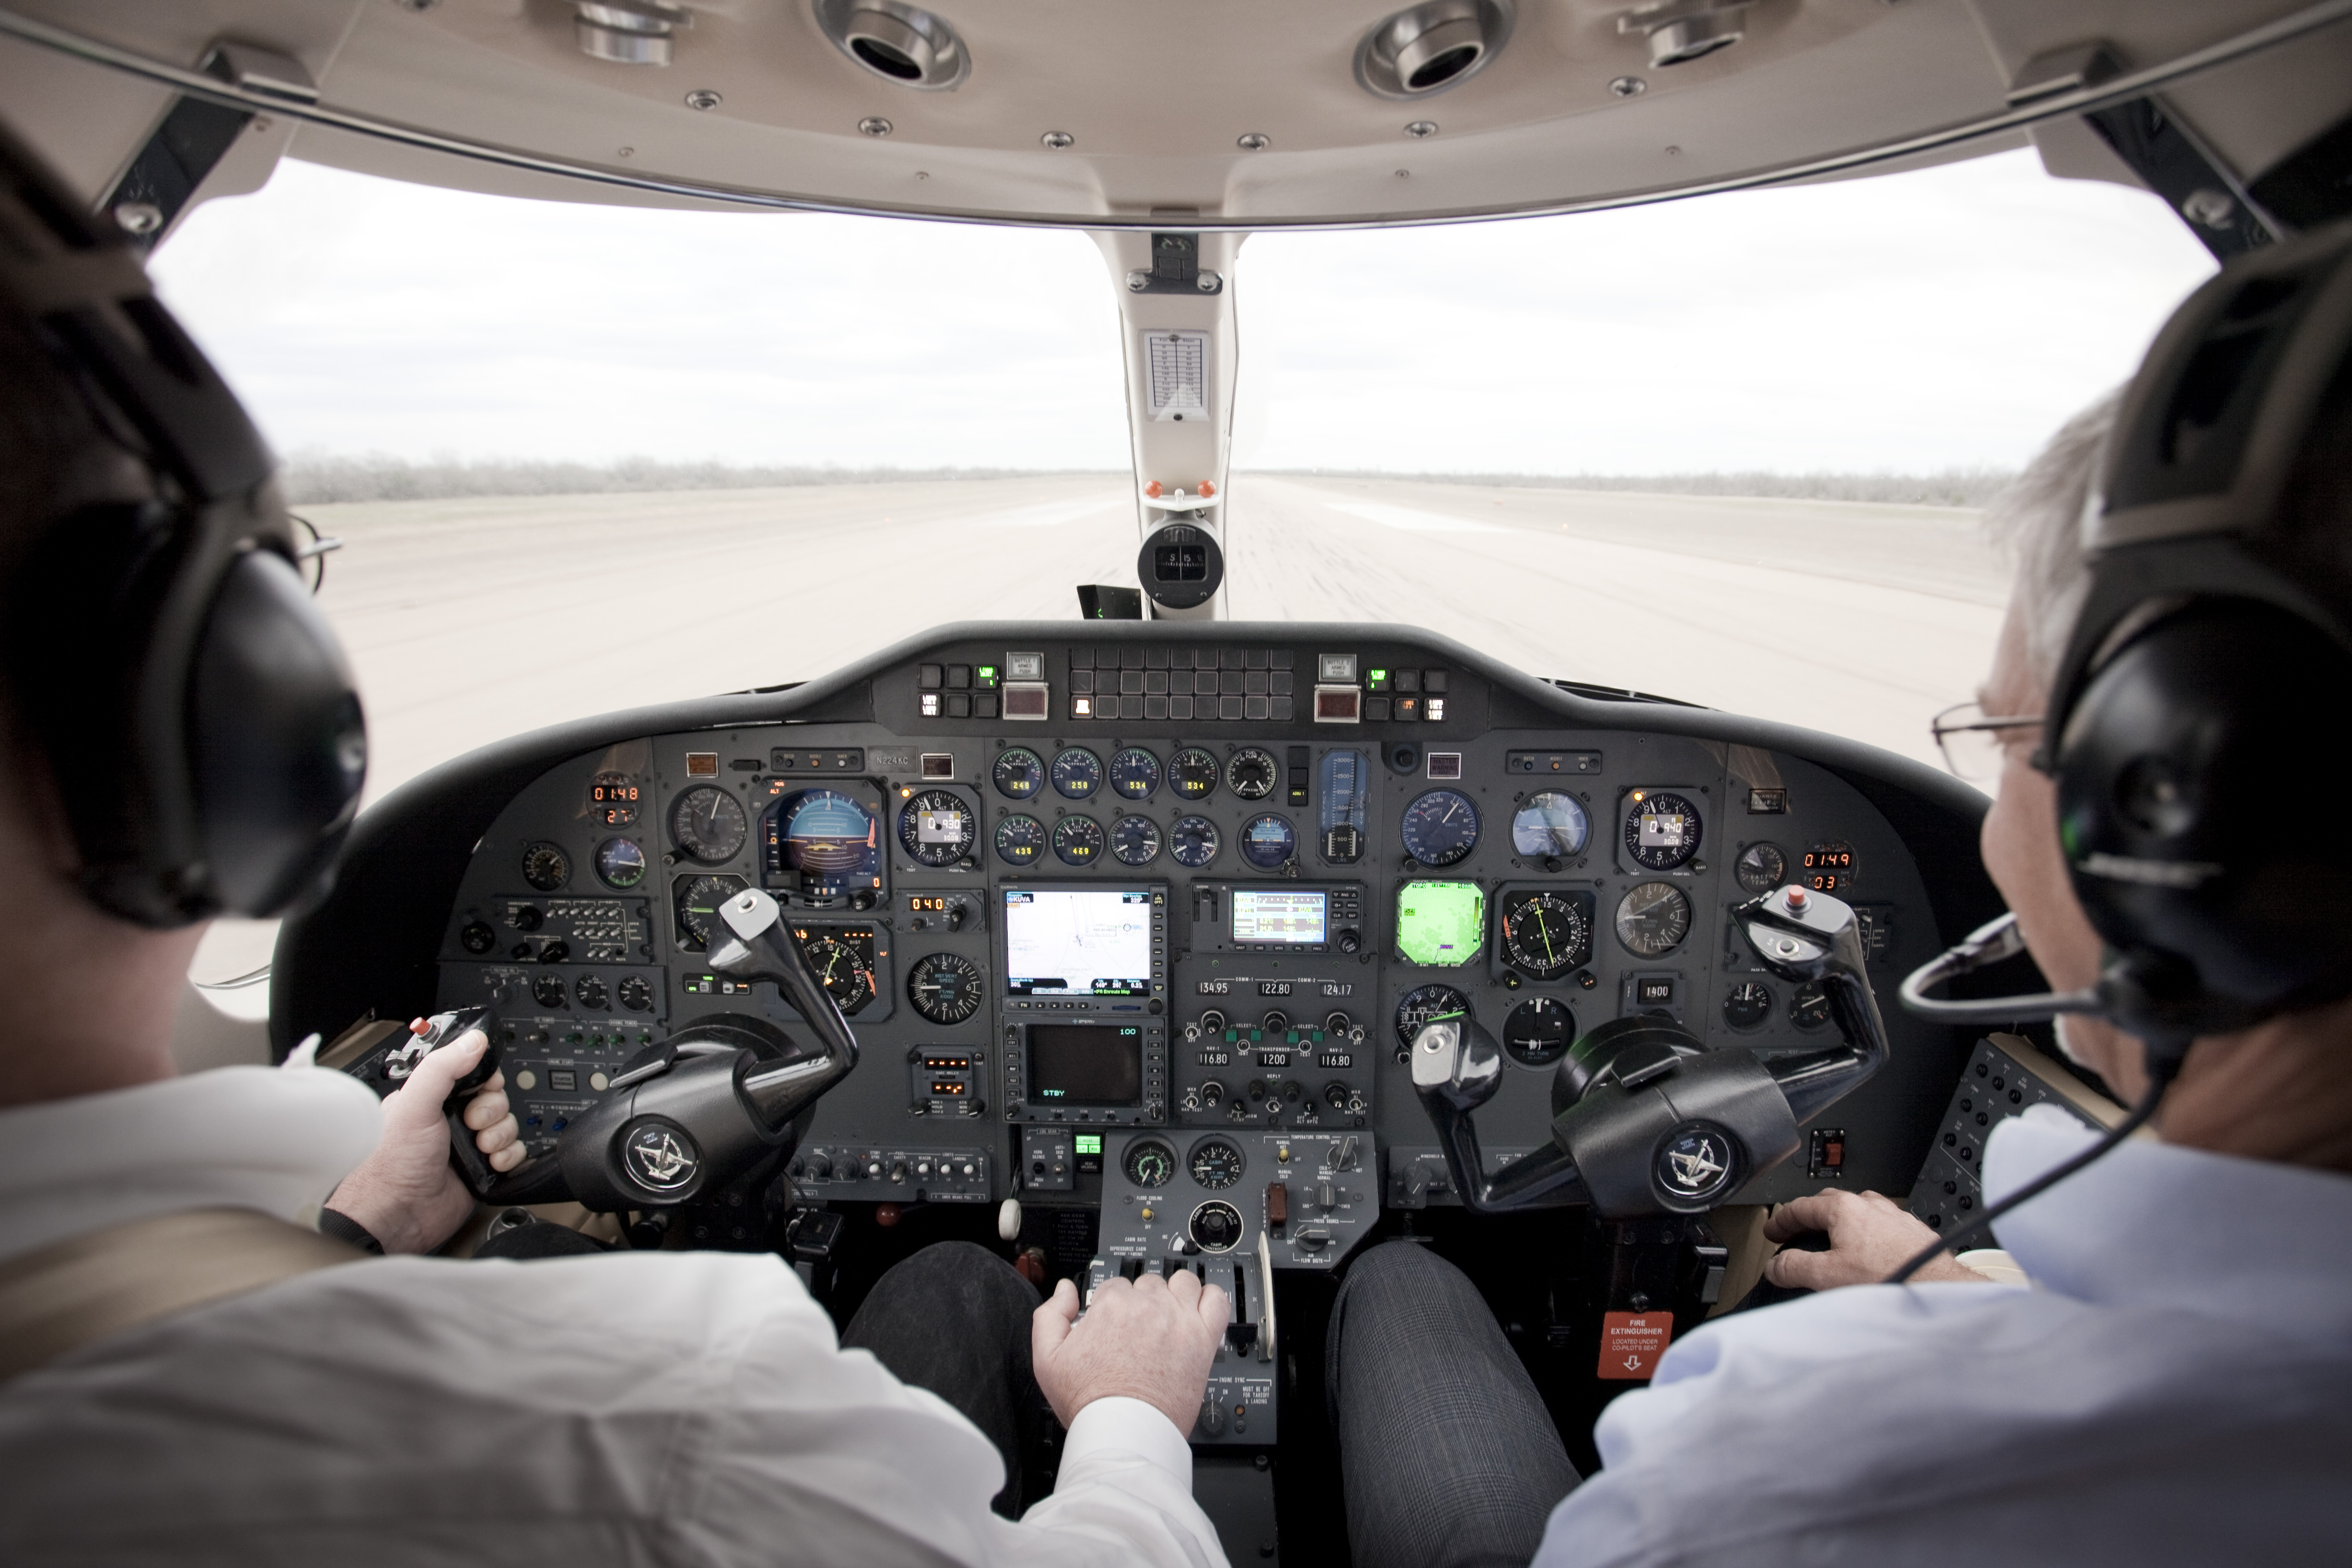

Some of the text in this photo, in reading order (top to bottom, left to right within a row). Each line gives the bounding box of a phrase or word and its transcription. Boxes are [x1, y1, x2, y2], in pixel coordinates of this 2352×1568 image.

[913, 899, 942, 910] 040
[1568, 916, 1575, 925] 21
[1200, 983, 1228, 993] 134.95
[1262, 983, 1290, 994] 122.80
[1323, 984, 1351, 995] 124.17
[1200, 1053, 1227, 1064] 116.80
[1264, 1054, 1285, 1065] 1200
[1322, 1055, 1349, 1066] 116.80
